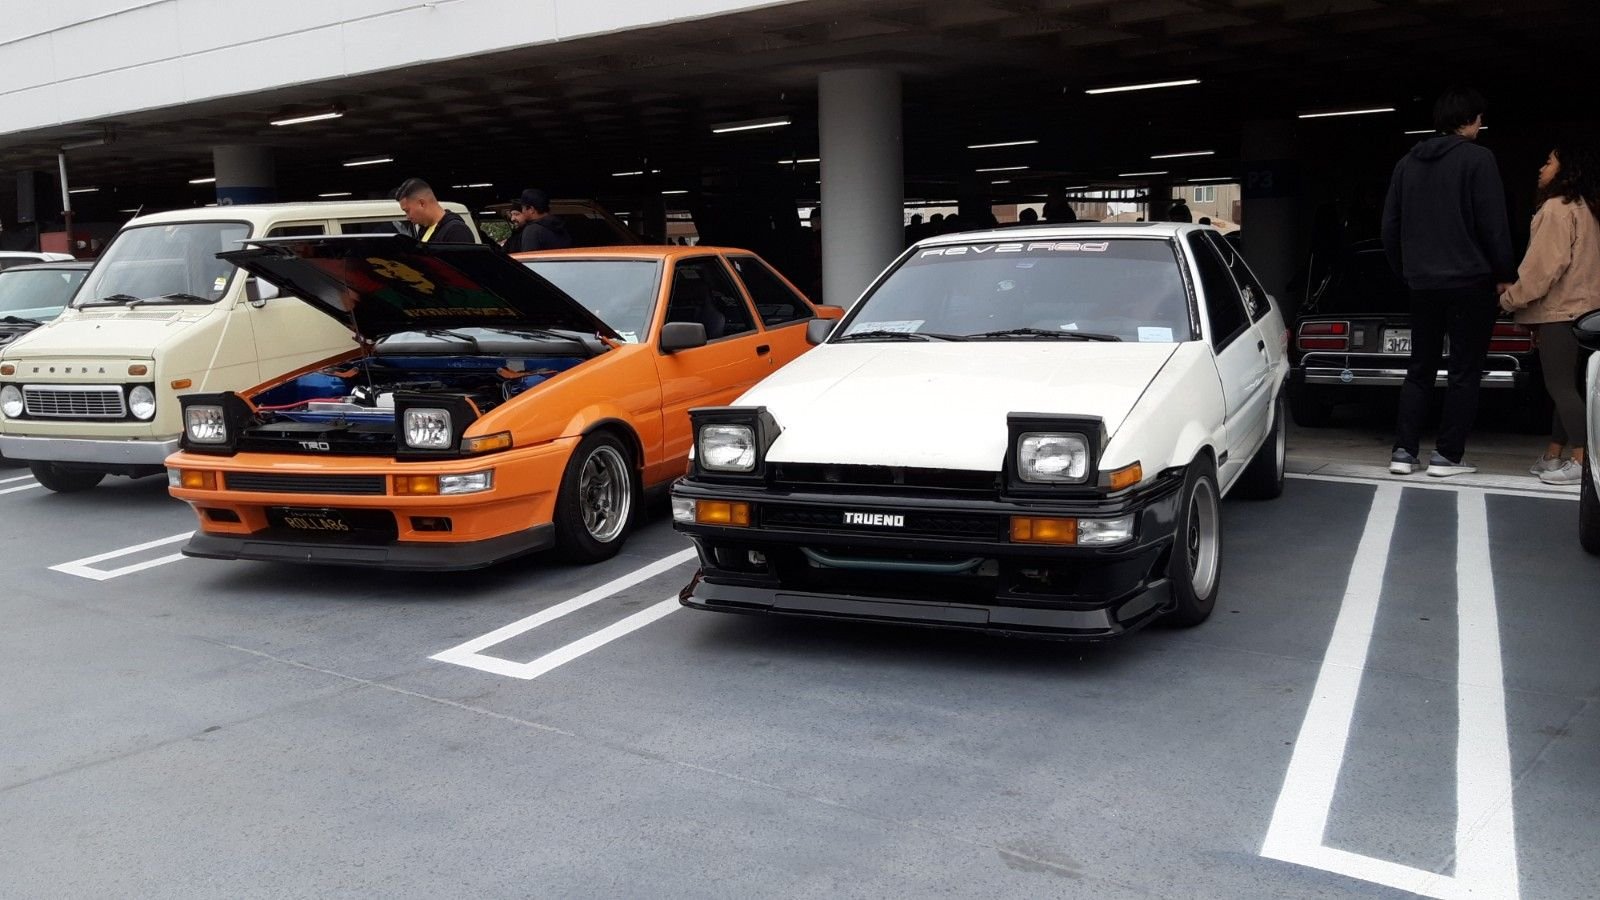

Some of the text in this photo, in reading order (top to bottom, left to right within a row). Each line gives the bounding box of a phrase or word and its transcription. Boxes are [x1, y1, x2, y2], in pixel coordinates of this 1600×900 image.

[1247, 171, 1272, 189] P3
[1386, 338, 1411, 352] 3HZ
[33, 366, 105, 374] HONDA
[299, 441, 330, 450] TRD
[284, 517, 349, 531] ROLLA86
[844, 512, 904, 526] TRUENO
